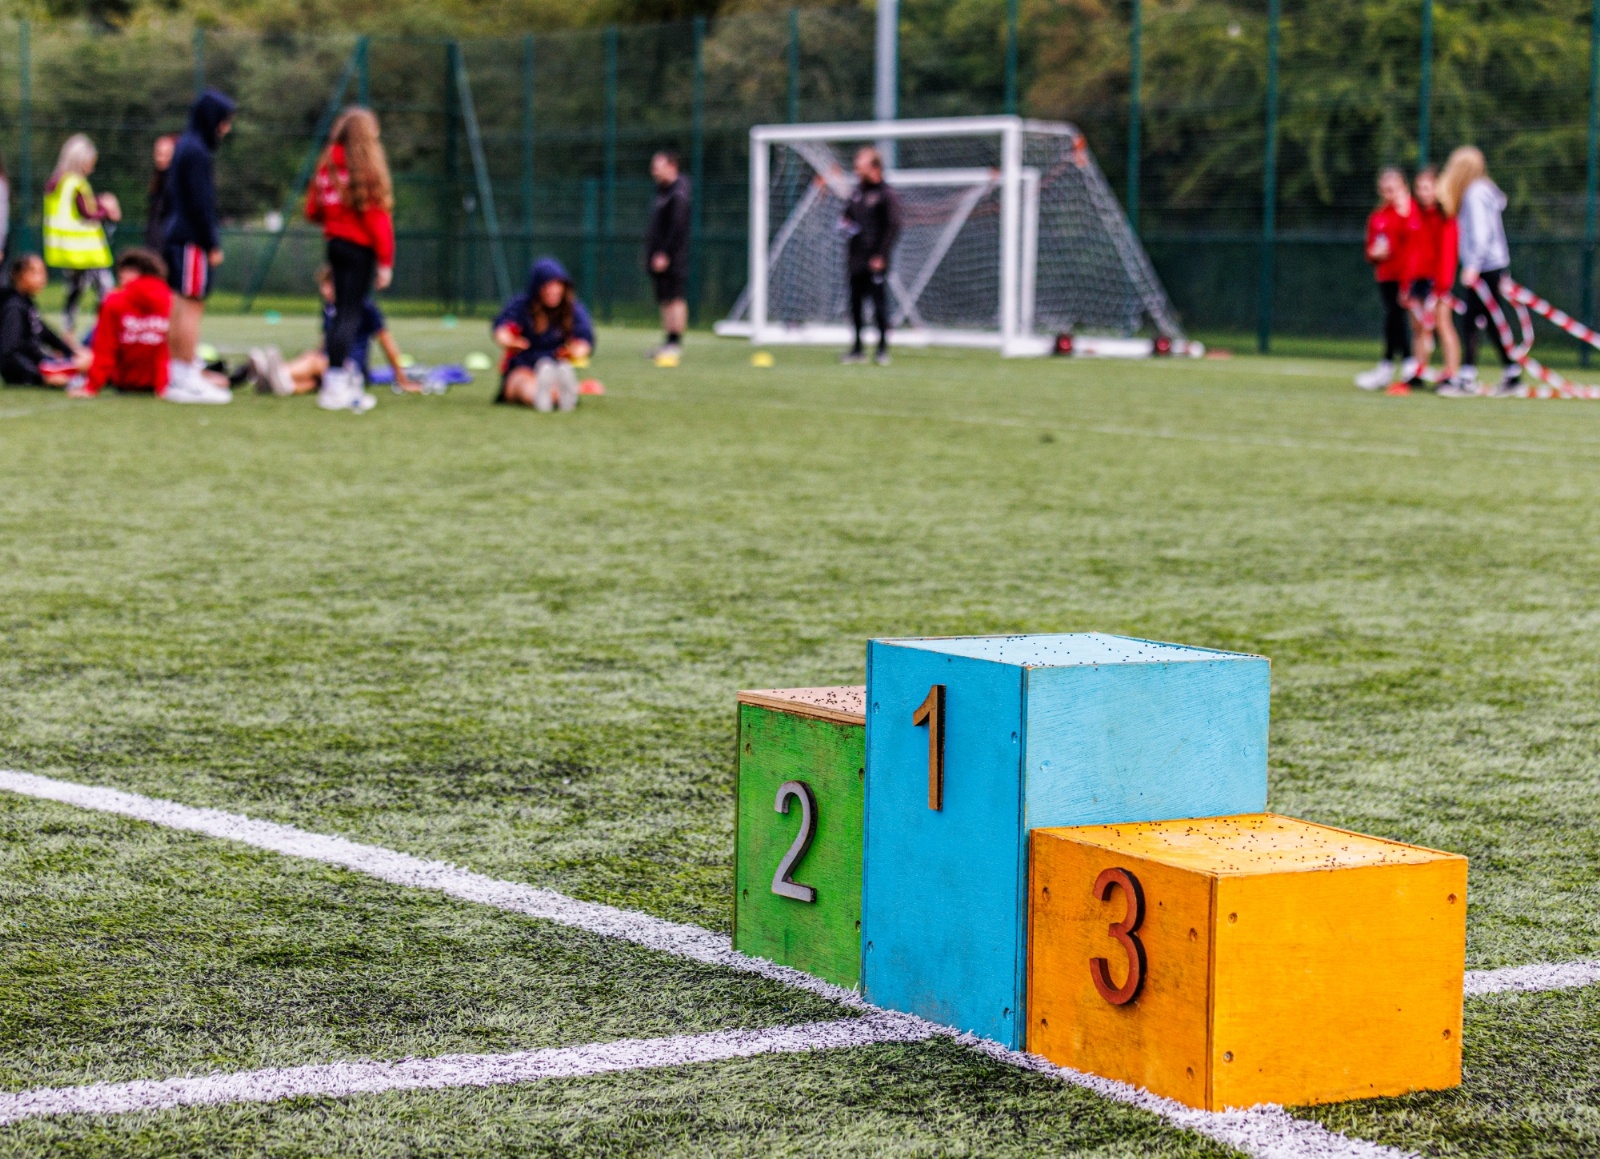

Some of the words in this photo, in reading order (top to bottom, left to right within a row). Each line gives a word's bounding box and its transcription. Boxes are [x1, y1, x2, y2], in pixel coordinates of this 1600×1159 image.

[912, 684, 946, 811] 1
[771, 780, 818, 902] 2
[1090, 867, 1147, 1005] 3
